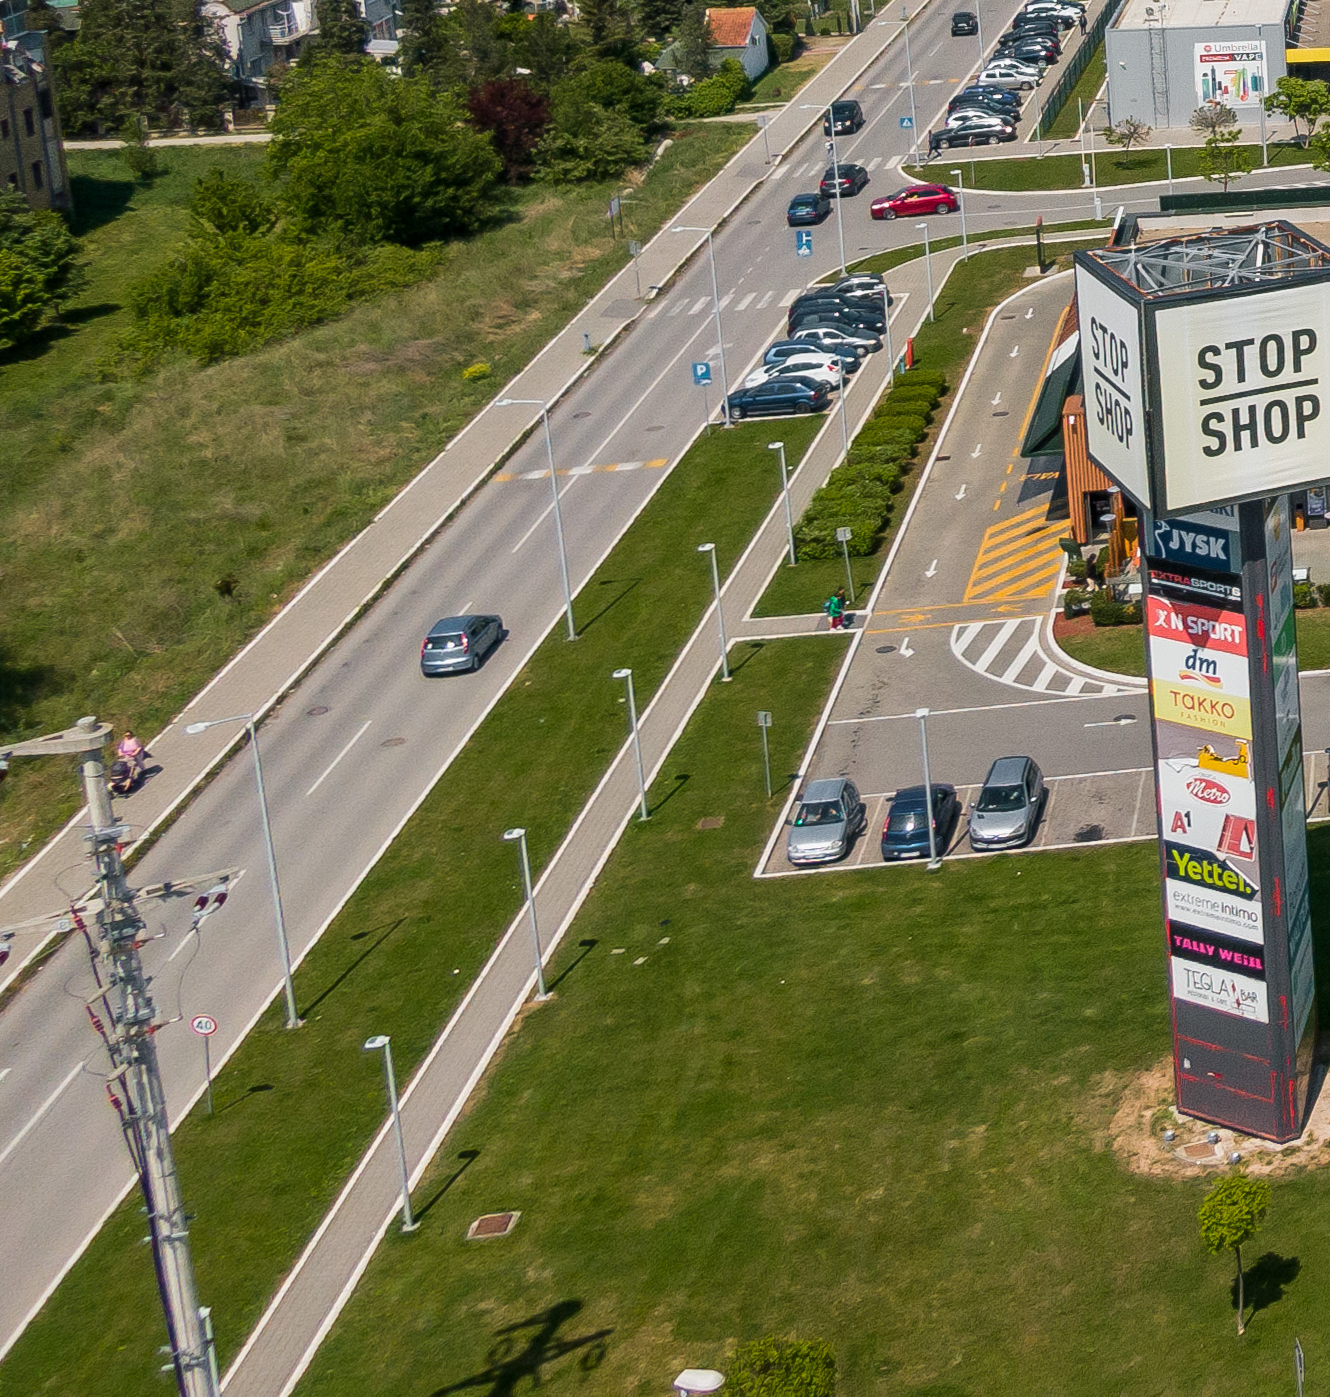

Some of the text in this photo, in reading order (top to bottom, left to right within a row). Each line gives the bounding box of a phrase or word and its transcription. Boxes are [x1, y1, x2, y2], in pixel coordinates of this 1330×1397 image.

[1214, 43, 1259, 53] Umbrella
[1233, 52, 1262, 61] VAPE
[1090, 316, 1129, 384] STOP
[1197, 327, 1318, 391] STOP
[1094, 381, 1133, 451] SHOP
[1201, 393, 1322, 458] SHOP
[1169, 528, 1227, 560] JYSK
[1187, 615, 1243, 644] SPORT
[1185, 647, 1217, 676] dm
[1180, 711, 1226, 728] FASHION
[1189, 779, 1229, 803] Metro
[1171, 810, 1192, 834] A1
[1173, 890, 1258, 923] extreme Intimo
[1174, 935, 1215, 956] TALLY
[1183, 967, 1230, 998] TEGLA
[196, 1020, 212, 1030] 40
